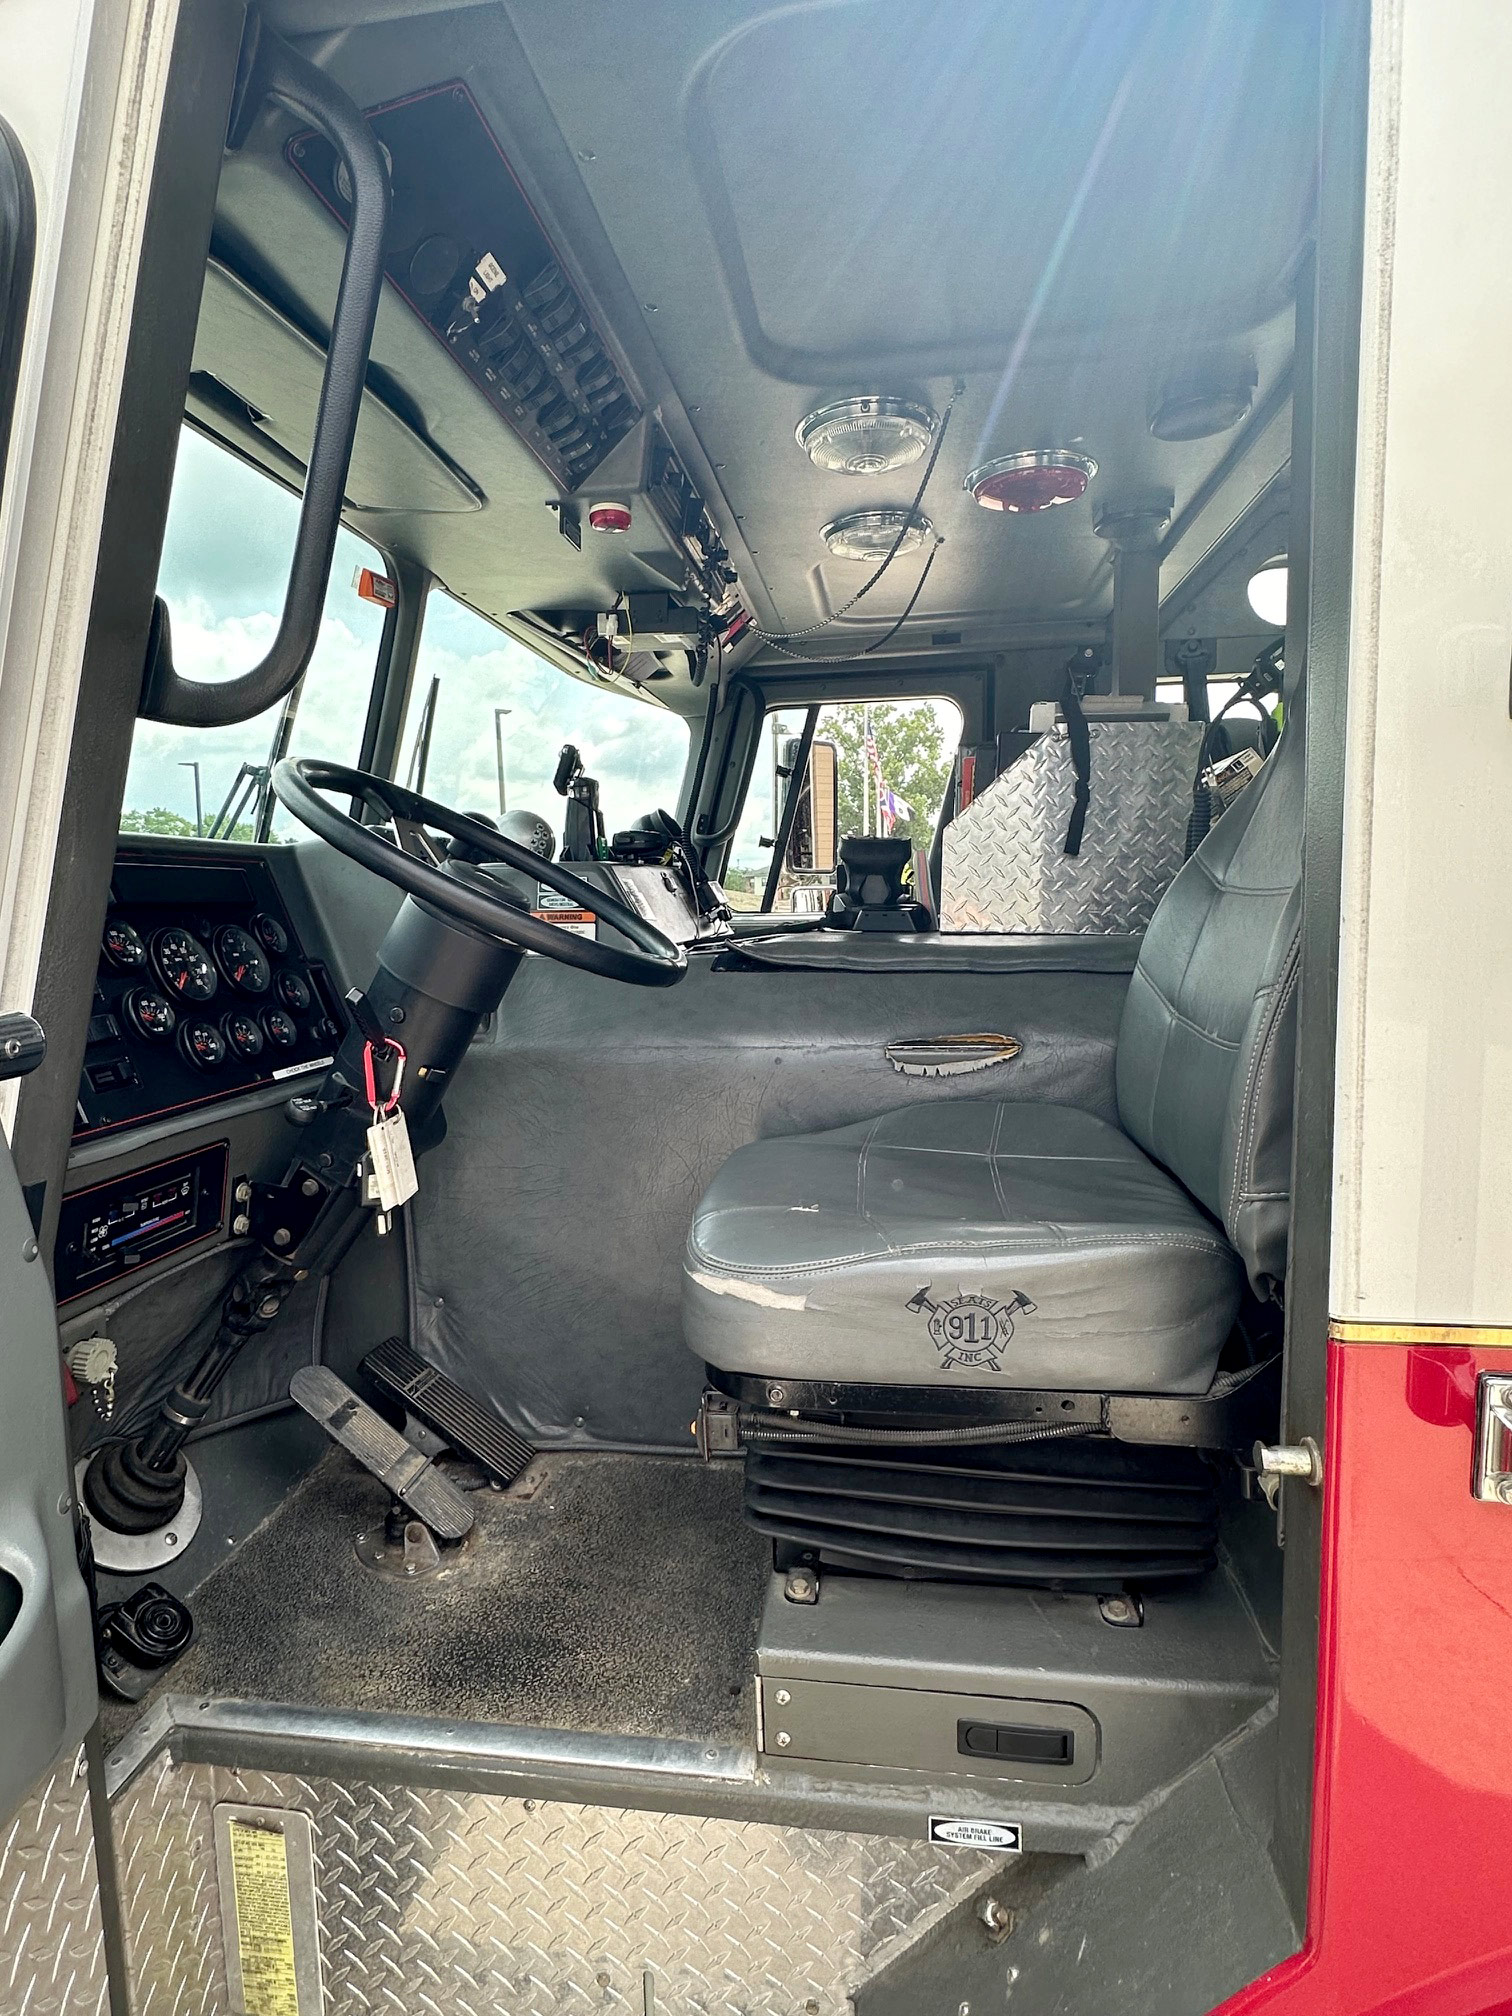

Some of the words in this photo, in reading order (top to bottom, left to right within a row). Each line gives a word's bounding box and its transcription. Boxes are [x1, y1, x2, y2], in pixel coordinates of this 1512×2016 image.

[546, 913, 583, 921] WARNING
[950, 1296, 992, 1308] SEATS
[949, 1312, 992, 1343] 911
[958, 1352, 982, 1362] INC
[946, 1831, 972, 1840] SYSTEM
[973, 1834, 987, 1842] FILL
